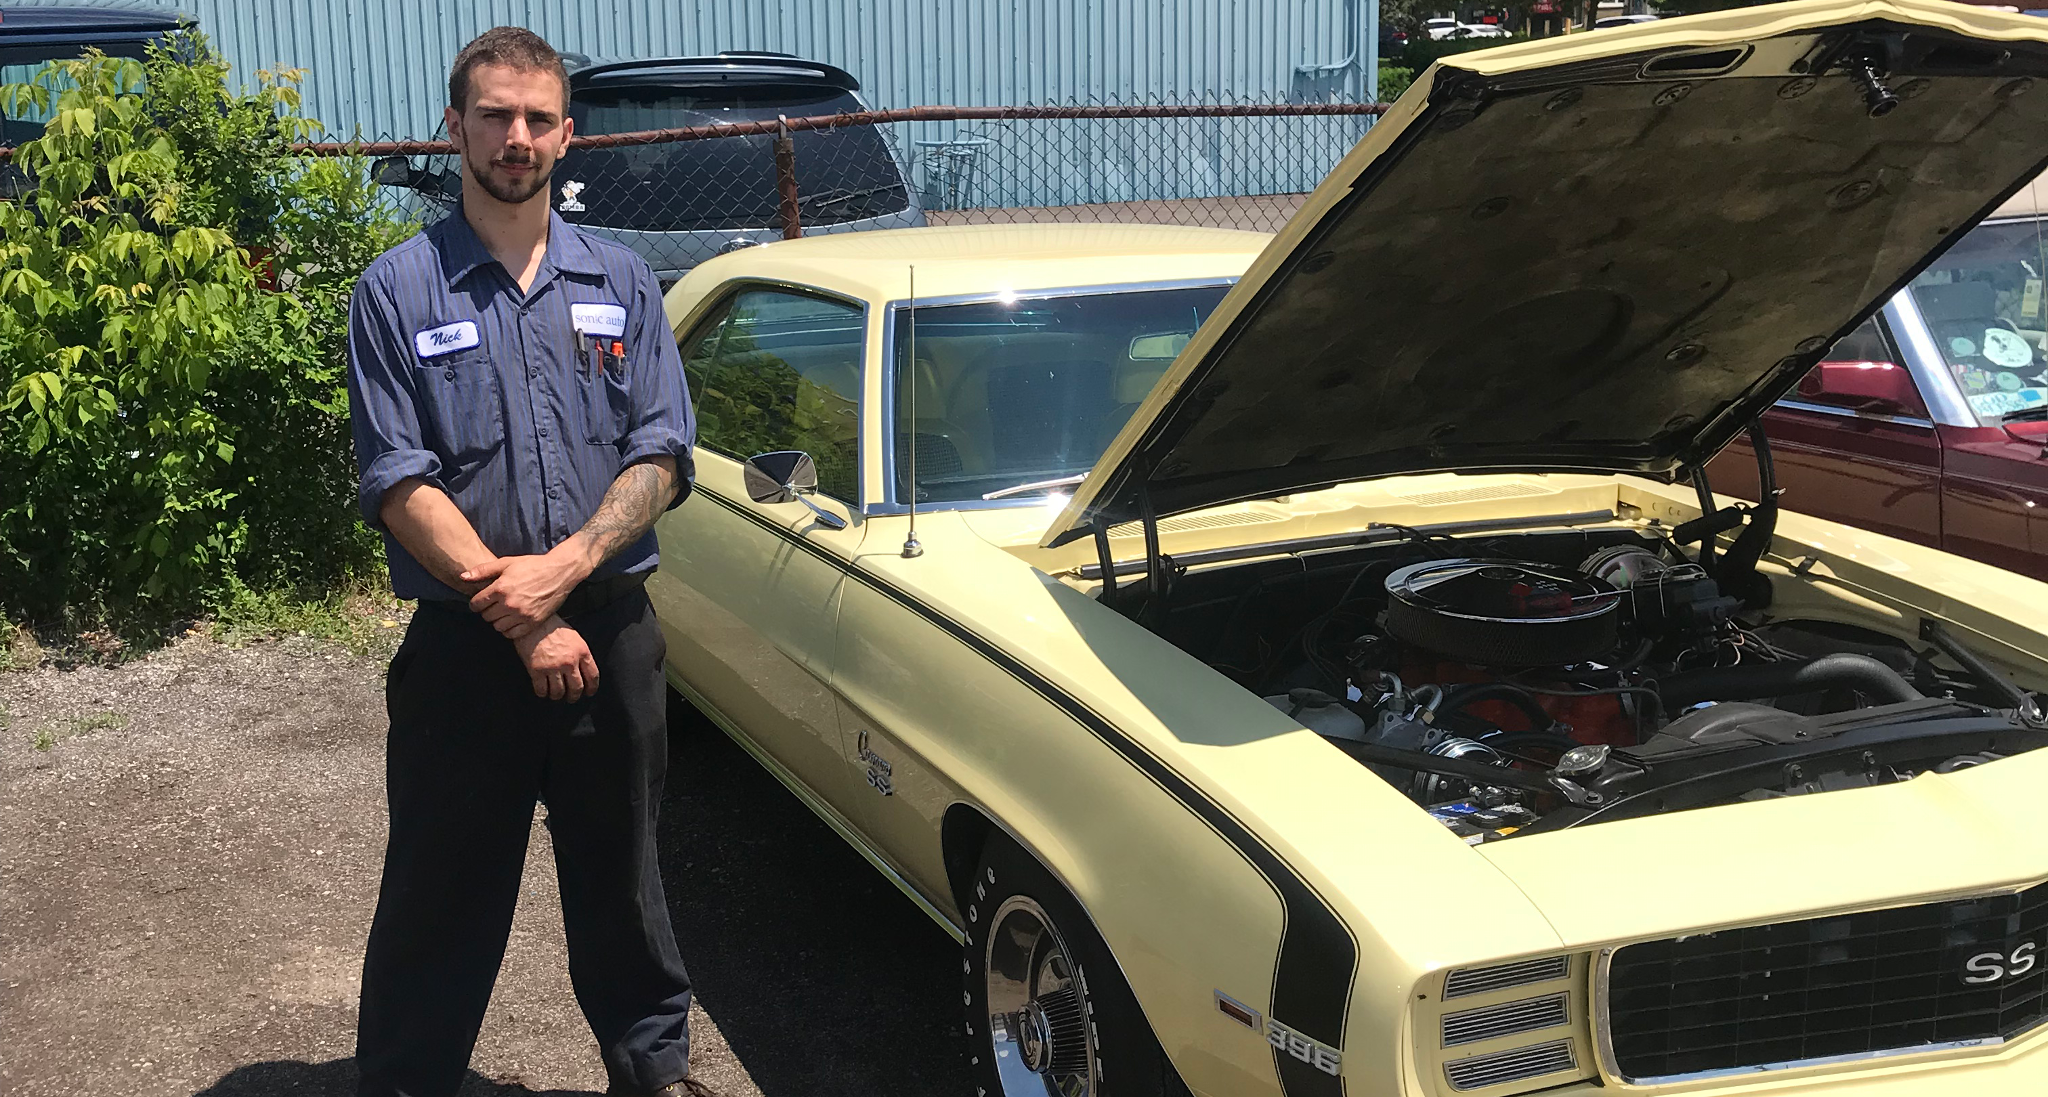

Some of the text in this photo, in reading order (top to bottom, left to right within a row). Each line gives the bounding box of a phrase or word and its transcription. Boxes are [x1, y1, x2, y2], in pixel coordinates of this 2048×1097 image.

[575, 314, 625, 327] sonic auto
[430, 328, 463, 347] Nick
[867, 768, 893, 796] SS
[1965, 942, 2036, 984] SS
[1266, 1020, 1343, 1077] 396
